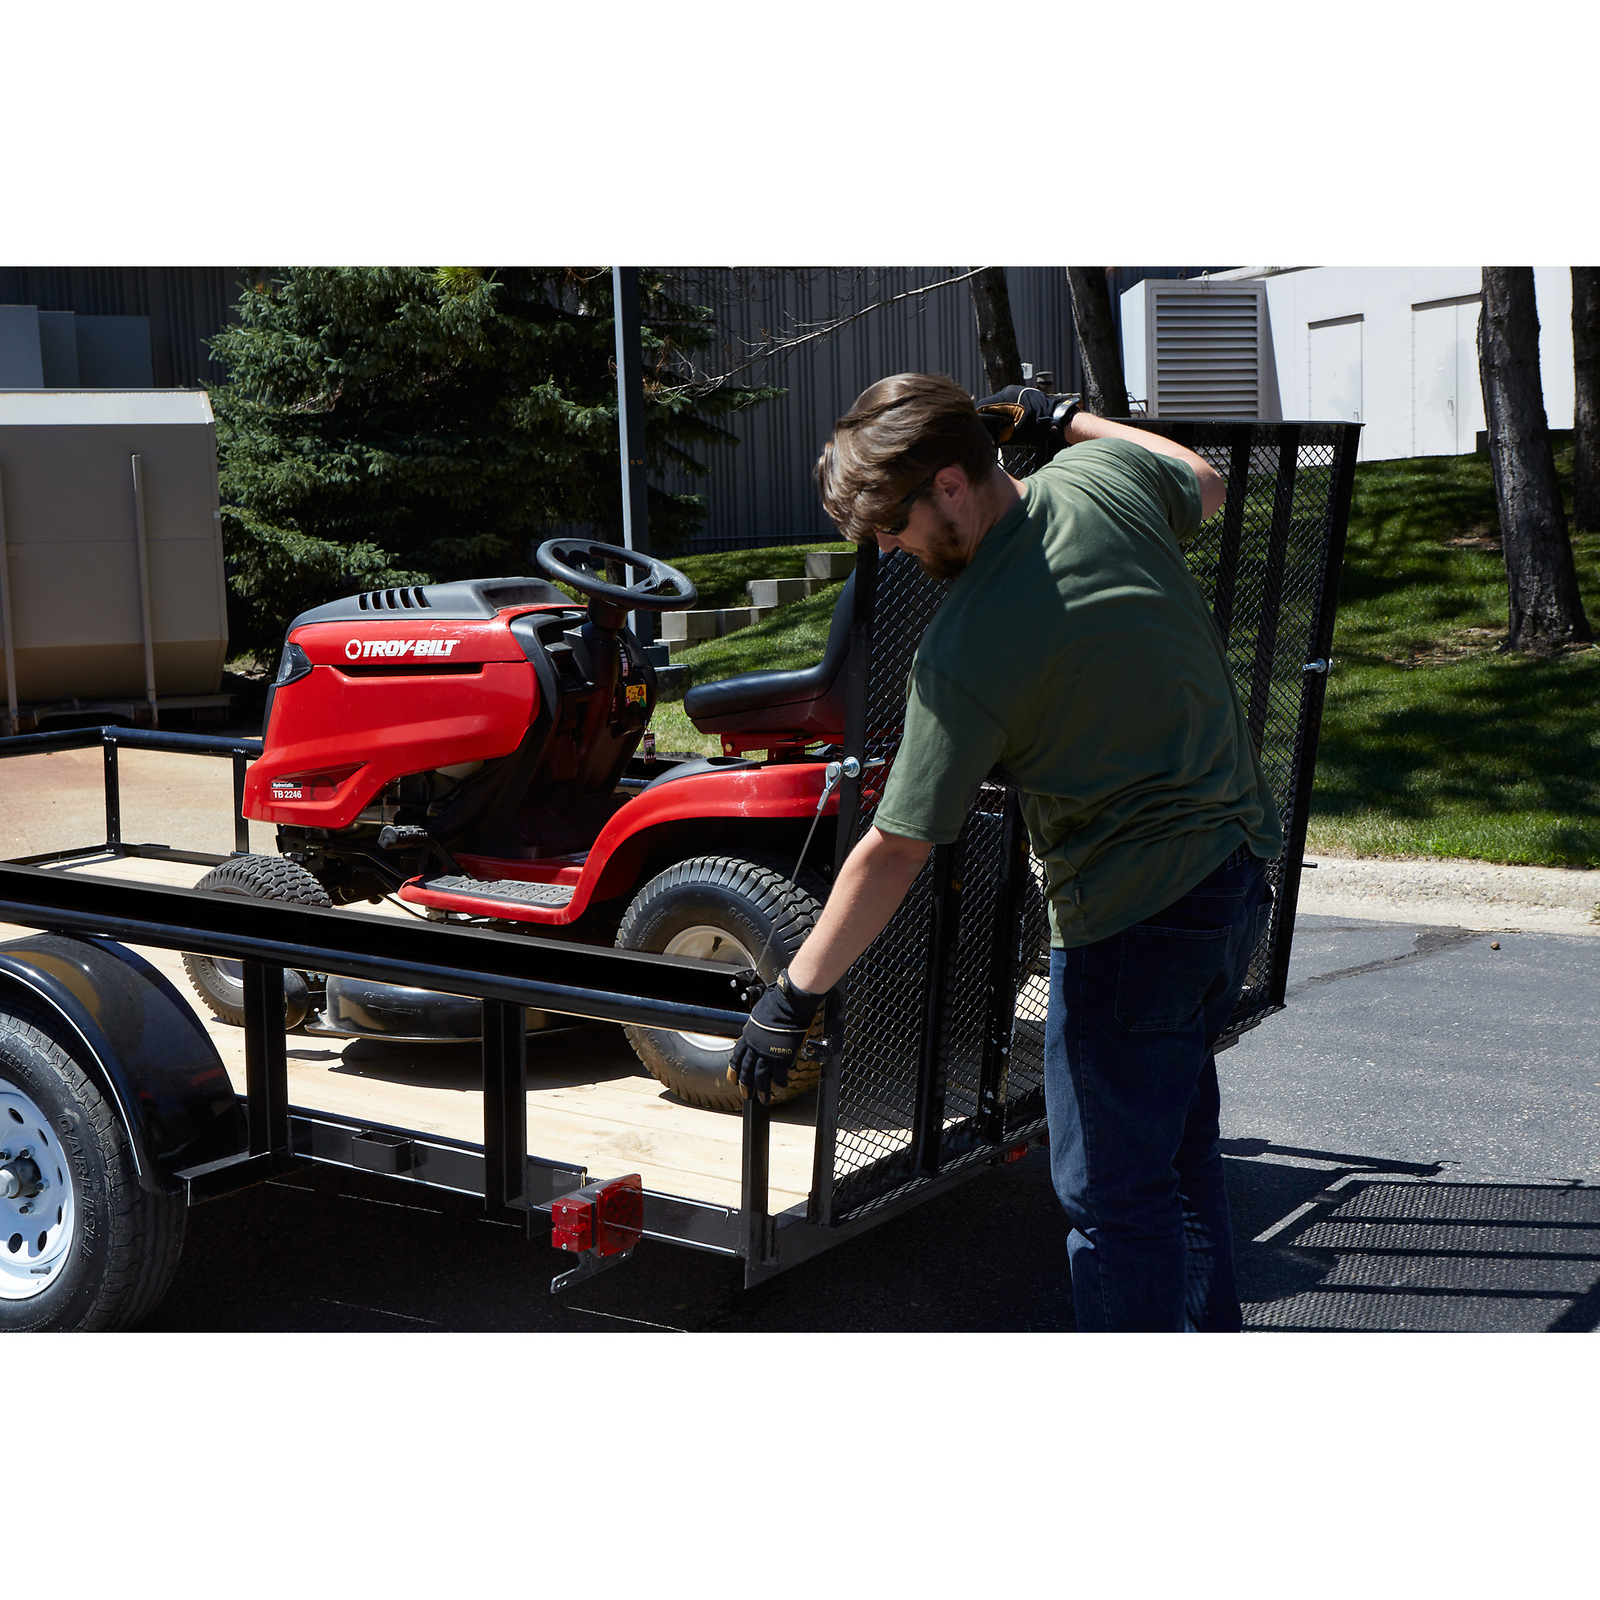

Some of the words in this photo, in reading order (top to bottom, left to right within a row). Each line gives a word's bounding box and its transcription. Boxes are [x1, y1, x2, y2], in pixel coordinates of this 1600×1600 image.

[362, 640, 458, 657] TROY-BILT
[273, 790, 284, 799] TB
[284, 790, 302, 799] 2246
[769, 1045, 793, 1055] HYBRID
[56, 1111, 97, 1266] CARLISLE
